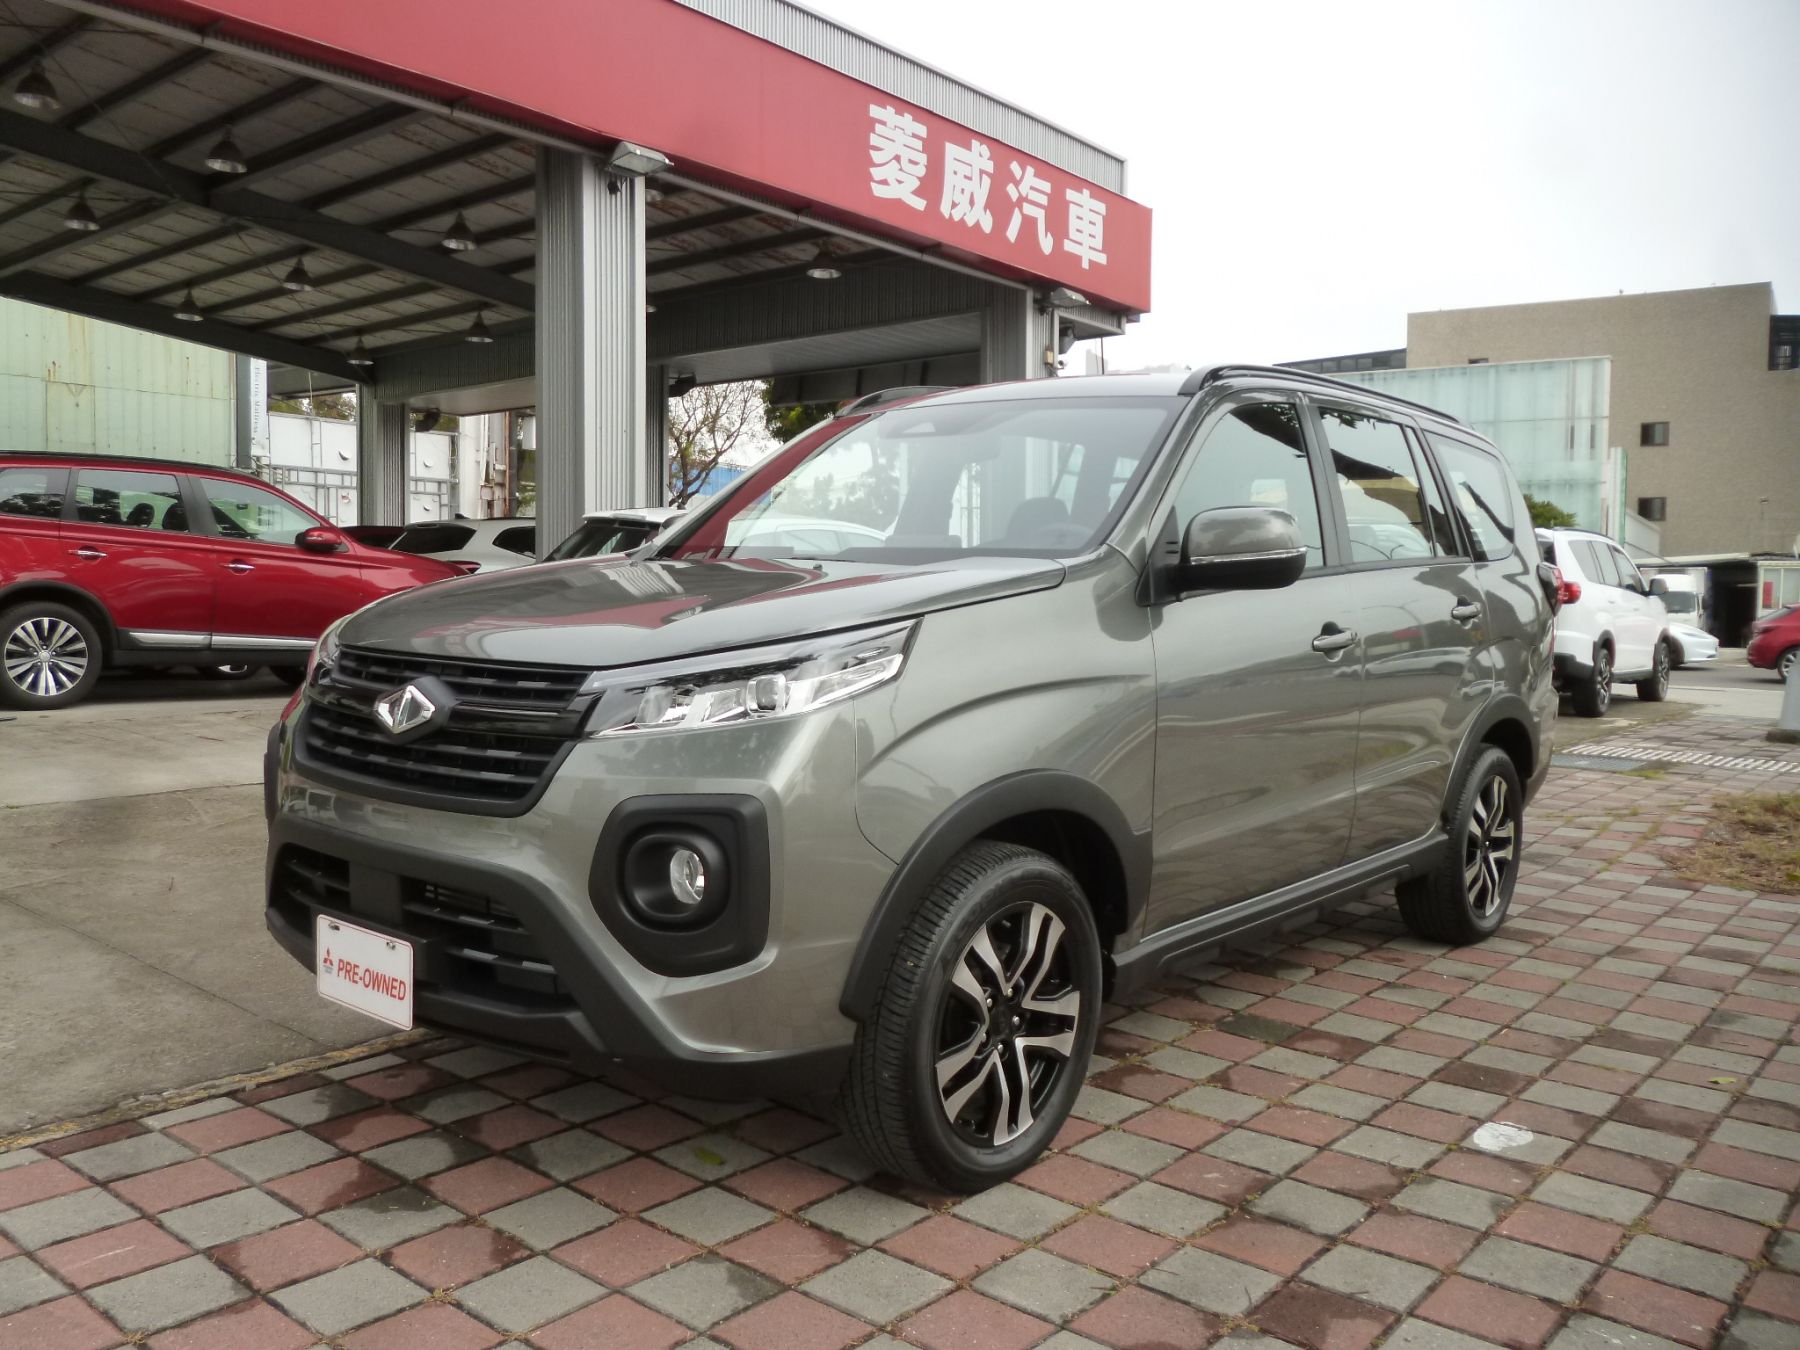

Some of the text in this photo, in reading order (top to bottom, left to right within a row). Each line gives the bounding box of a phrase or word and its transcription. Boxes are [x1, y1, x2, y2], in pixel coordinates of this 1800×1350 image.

[869, 104, 1107, 270] 菱威汽車
[337, 958, 407, 1001] PRE-OWNED
